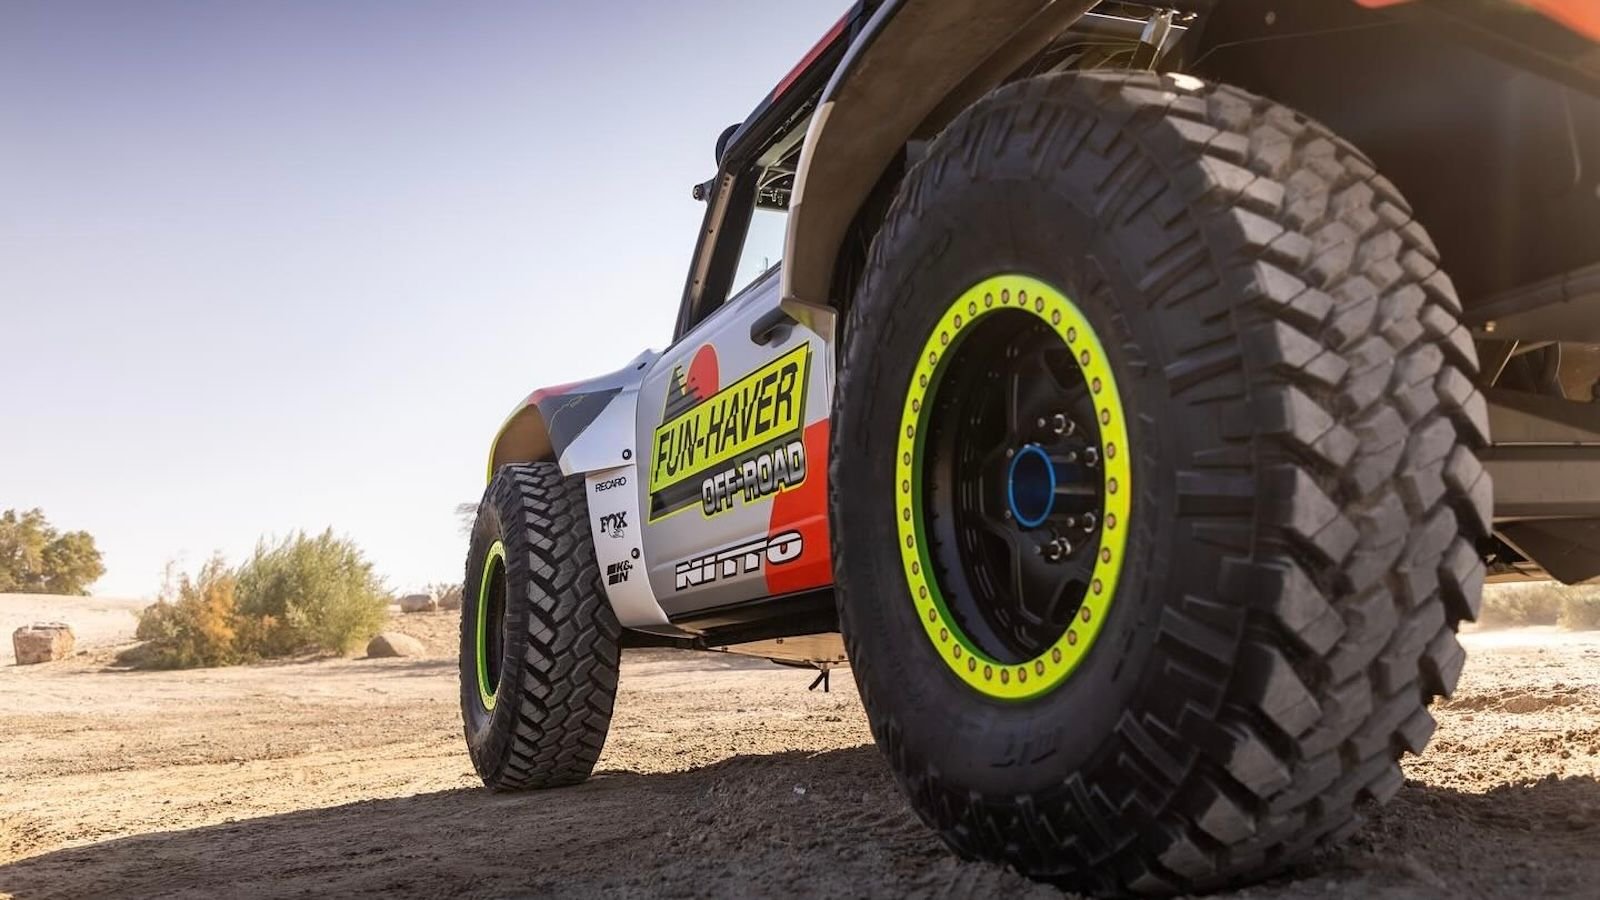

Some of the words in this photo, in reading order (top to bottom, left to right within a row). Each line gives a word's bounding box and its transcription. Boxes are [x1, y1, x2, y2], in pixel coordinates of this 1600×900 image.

[655, 361, 798, 483] FUN-HAVER
[595, 477, 627, 493] RECARO
[701, 440, 805, 516] OFF-ROAD
[600, 511, 628, 534] FOX
[675, 530, 803, 591] NITTO
